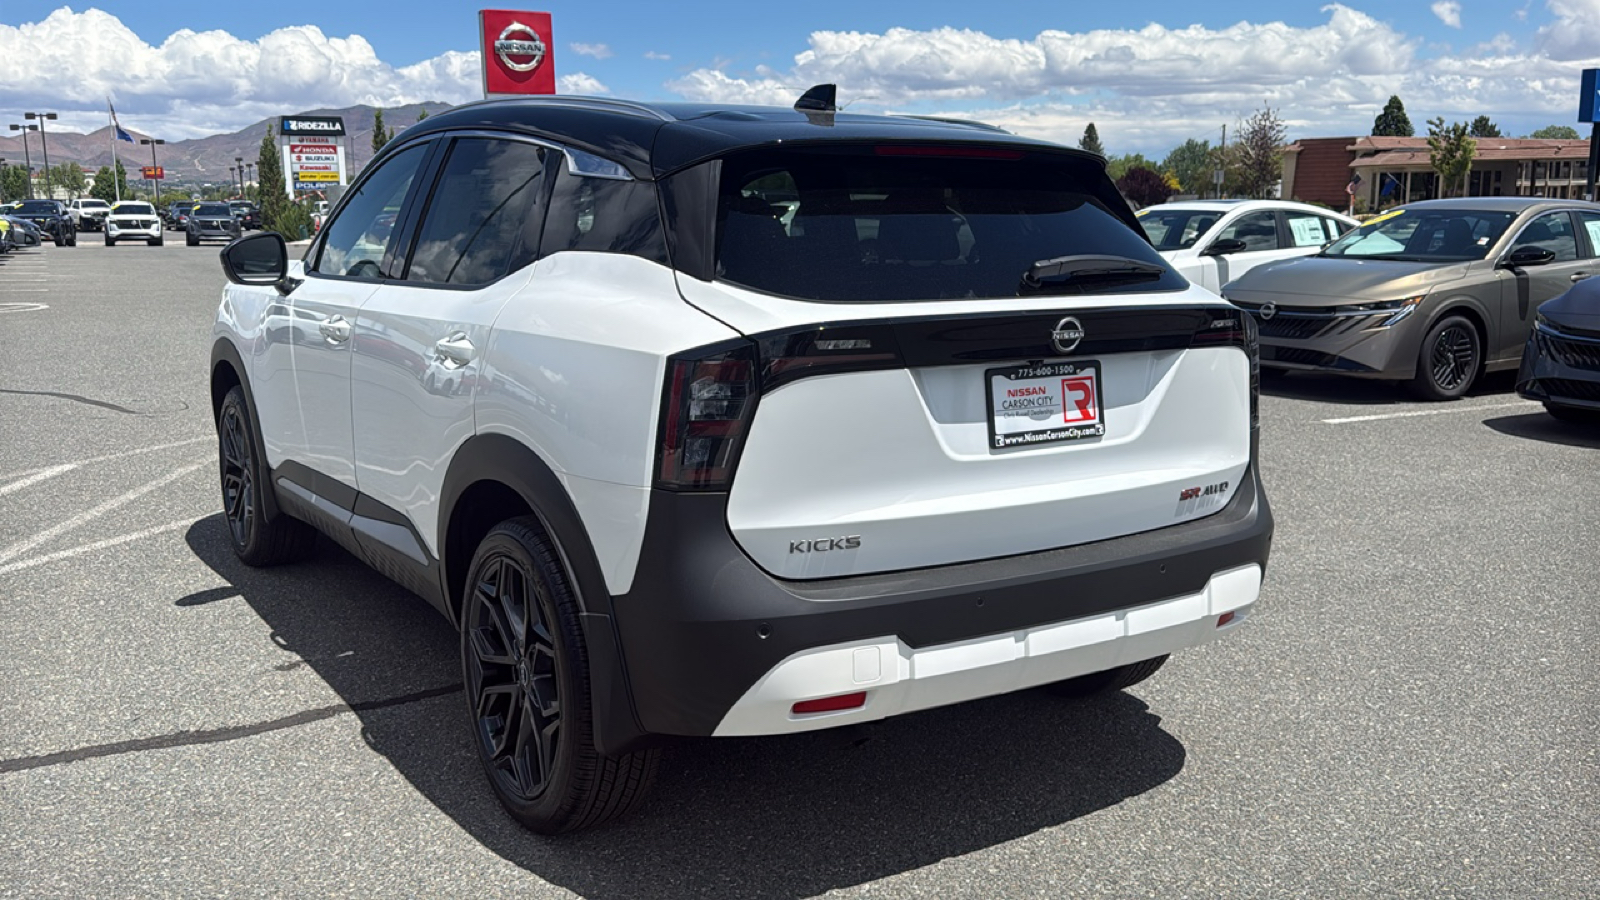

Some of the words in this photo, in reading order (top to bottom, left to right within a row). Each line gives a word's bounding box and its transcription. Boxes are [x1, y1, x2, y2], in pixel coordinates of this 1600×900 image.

[499, 42, 542, 52] NISSAN
[298, 120, 342, 130] RIDEZILLA
[1052, 330, 1085, 340] NISSAN
[1018, 365, 1074, 377] 775-600-1500
[1007, 386, 1046, 397] NISSAN
[1002, 398, 1035, 409] CARSON
[1036, 396, 1054, 406] CITY
[1005, 426, 1096, 445] www.NissanCarsonCity.com
[1179, 486, 1201, 501] SR
[1201, 481, 1229, 496] AWD
[789, 534, 861, 554] KICKS
